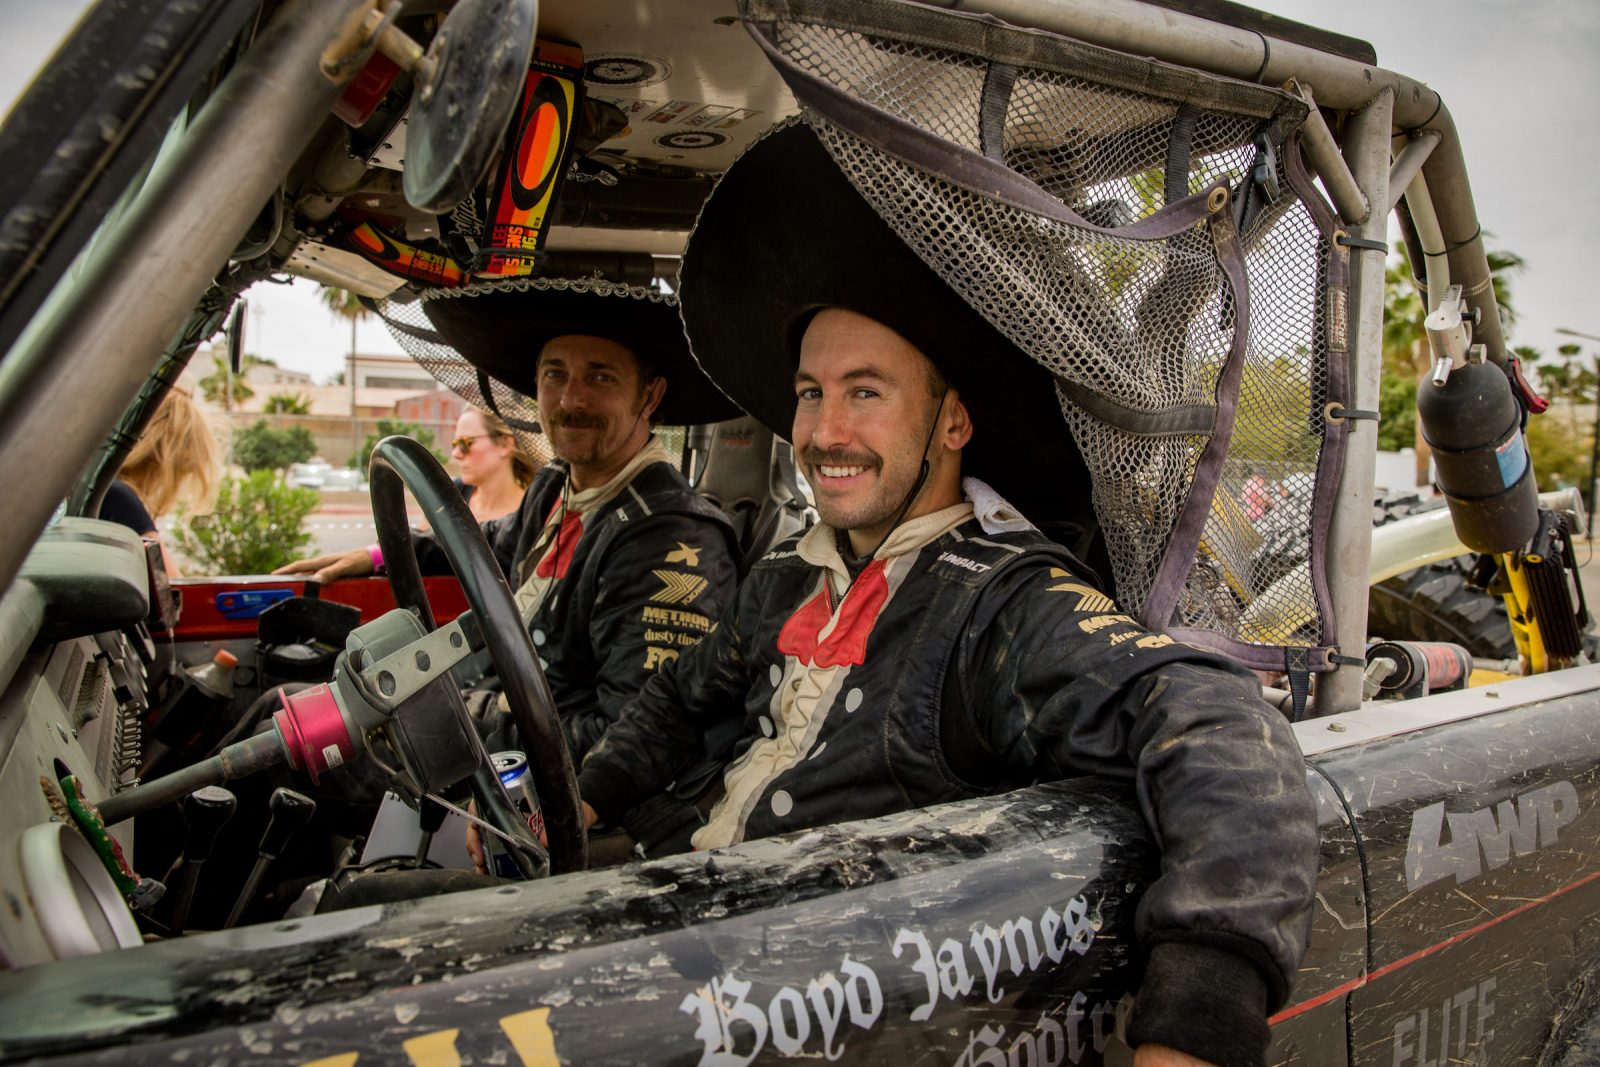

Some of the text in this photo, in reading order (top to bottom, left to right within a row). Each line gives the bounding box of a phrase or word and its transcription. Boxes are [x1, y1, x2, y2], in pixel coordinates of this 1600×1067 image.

[945, 553, 992, 573] IMPACT
[643, 606, 709, 627] METHOD
[644, 628, 675, 644] dusty
[643, 646, 680, 675] FO
[1403, 780, 1579, 893] 4WP
[679, 952, 884, 1067] Boyd
[892, 893, 1095, 1022] Jaynes
